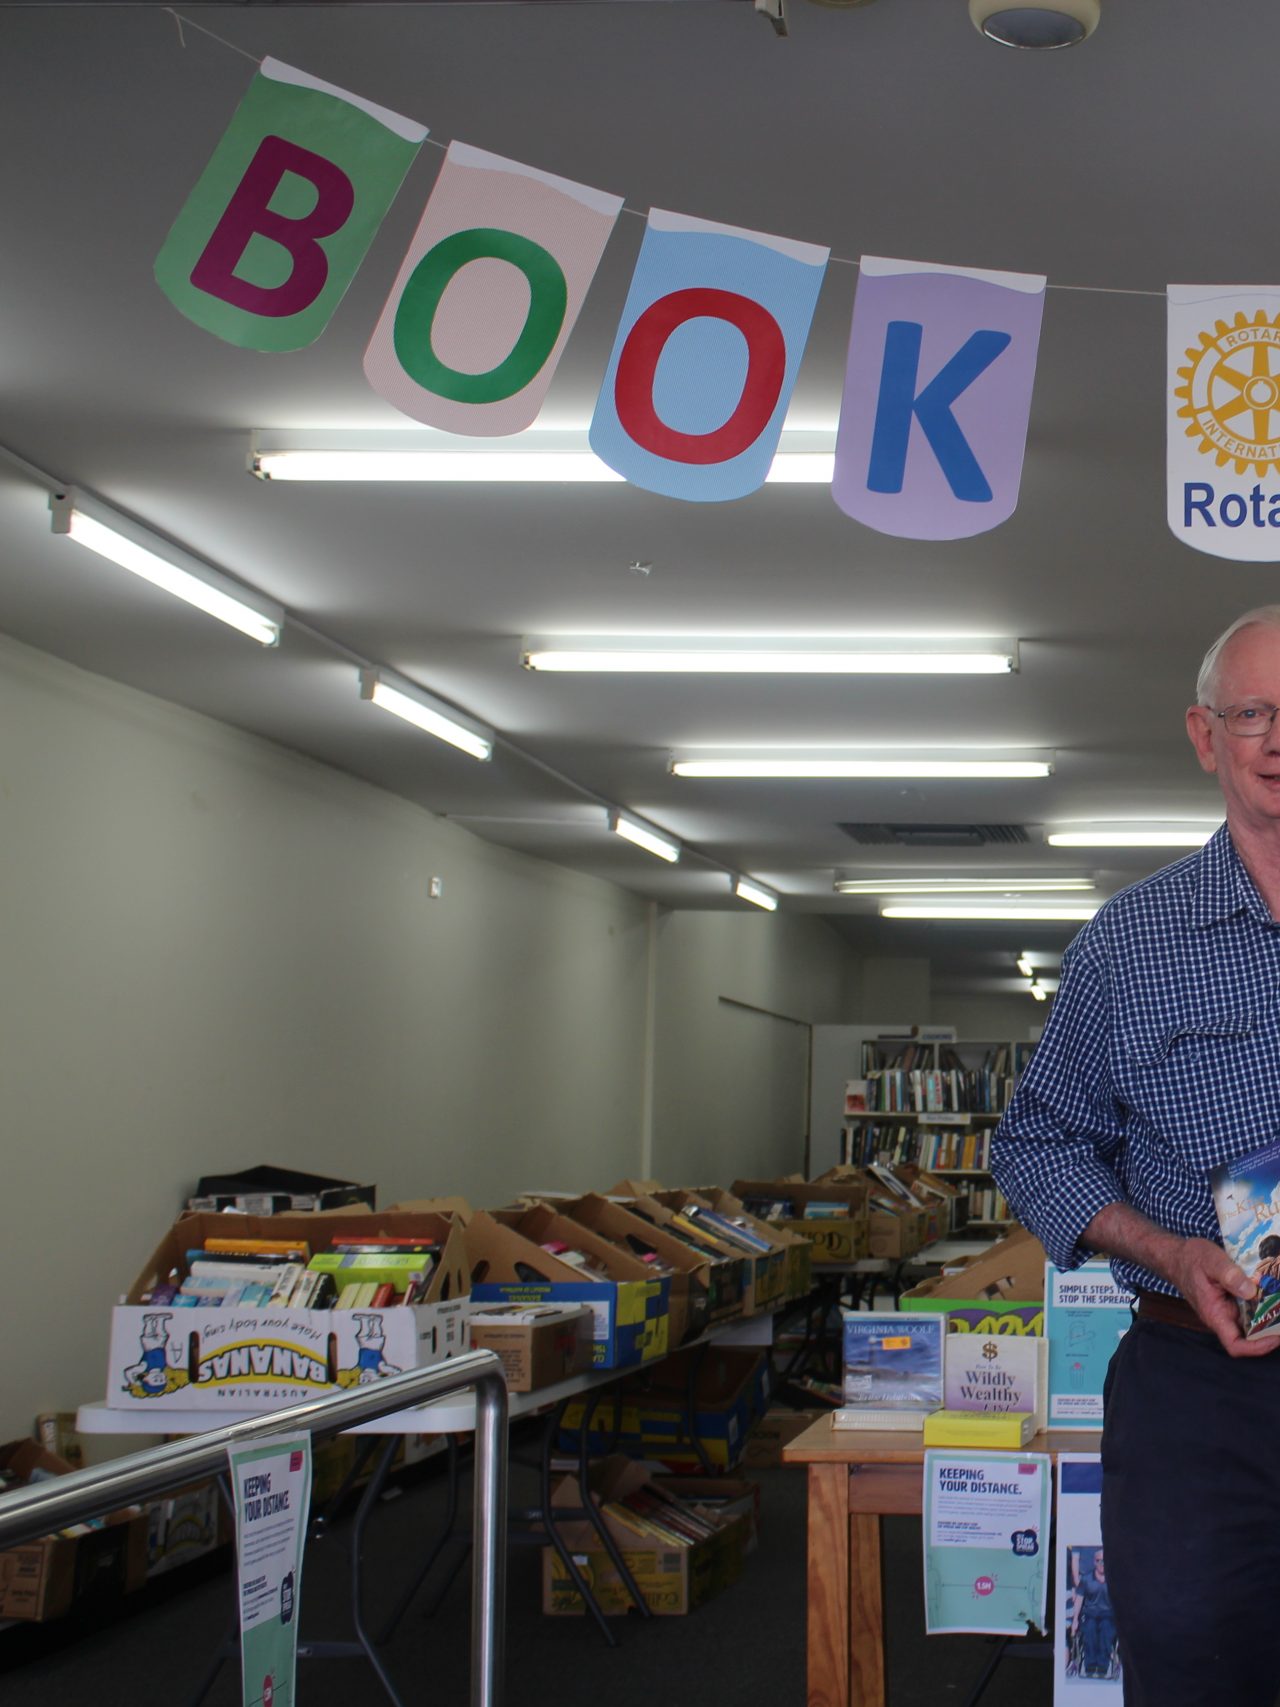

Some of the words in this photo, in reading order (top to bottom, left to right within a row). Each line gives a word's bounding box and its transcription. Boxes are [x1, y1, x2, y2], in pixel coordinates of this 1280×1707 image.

[1059, 1285, 1088, 1294] SIMPLE
[1090, 1285, 1114, 1294] STEPS
[1059, 1294, 1079, 1303] STOP
[1082, 1295, 1096, 1304] THE
[229, 1318, 258, 1336] body
[262, 1317, 290, 1331] your
[292, 1322, 323, 1341] Make
[846, 1324, 894, 1335] VIRGINIA
[897, 1324, 935, 1334] WOOLF
[198, 1343, 329, 1384] BANANAS
[965, 1371, 1016, 1388] Wildly
[217, 1388, 308, 1398] AUSTRALIAN
[960, 1385, 1022, 1405] Wealthy
[939, 1467, 985, 1482] KEEPING
[243, 1472, 272, 1499] KEEPING
[939, 1479, 968, 1493] YOUR
[970, 1482, 1022, 1495] DISTANCE.
[244, 1498, 262, 1524] YOUR
